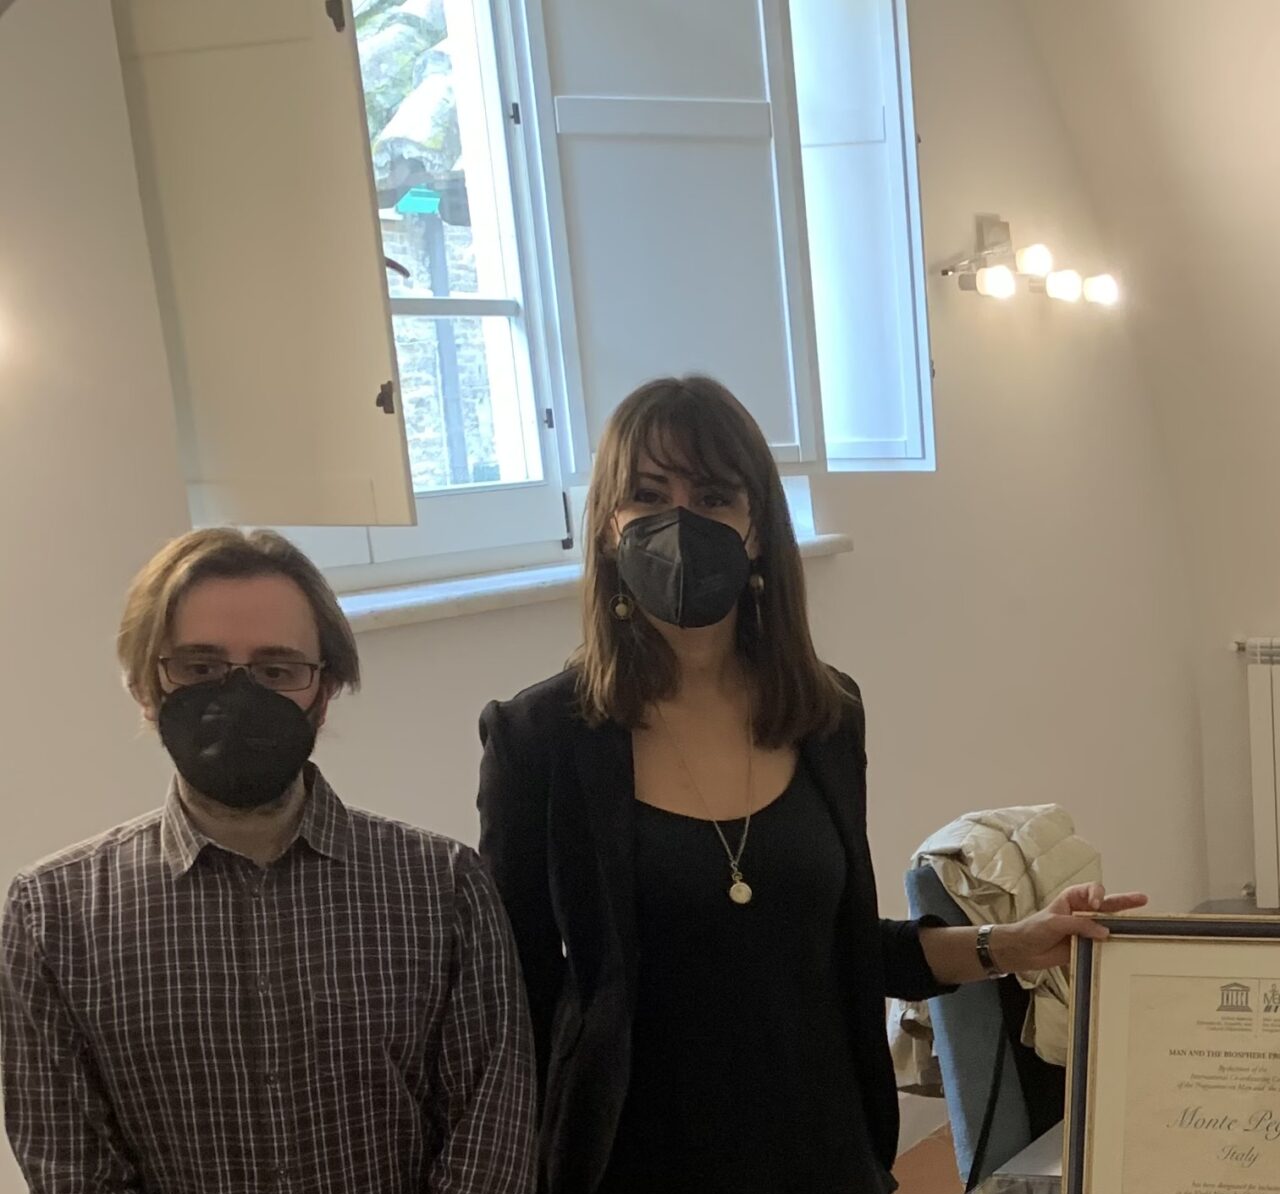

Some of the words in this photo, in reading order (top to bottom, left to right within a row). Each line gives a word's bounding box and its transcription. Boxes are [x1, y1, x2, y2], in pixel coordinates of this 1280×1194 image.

[1188, 1049, 1205, 1057] AND
[1223, 1050, 1265, 1059] BIOSPHERE
[1166, 1106, 1238, 1131] Monte
[1217, 1146, 1259, 1168] Italy
